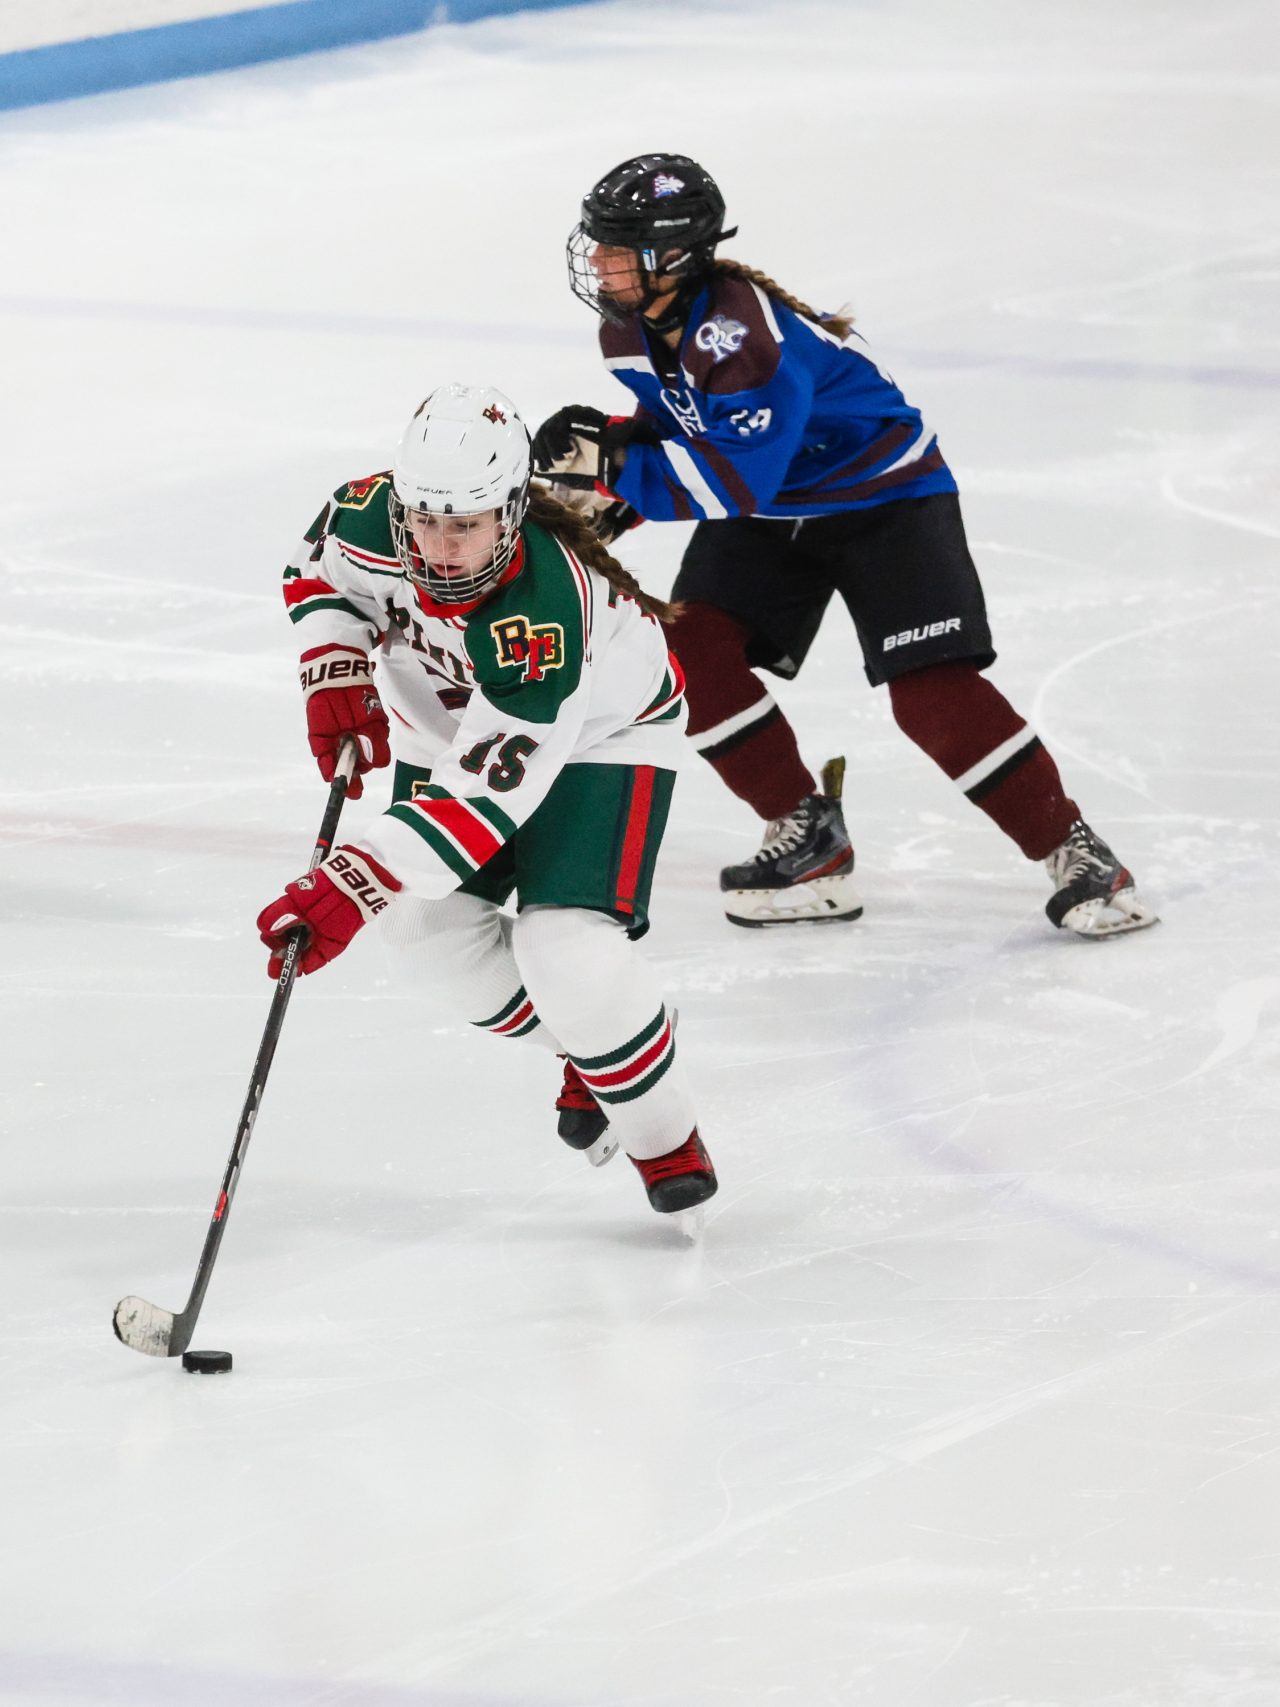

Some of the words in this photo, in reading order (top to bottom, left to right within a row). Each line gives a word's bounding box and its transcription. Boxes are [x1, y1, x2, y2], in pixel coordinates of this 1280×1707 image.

[882, 617, 961, 652] BAUER
[300, 659, 370, 691] AUER
[327, 854, 389, 915] BAUE
[279, 935, 300, 986] TSPEED
